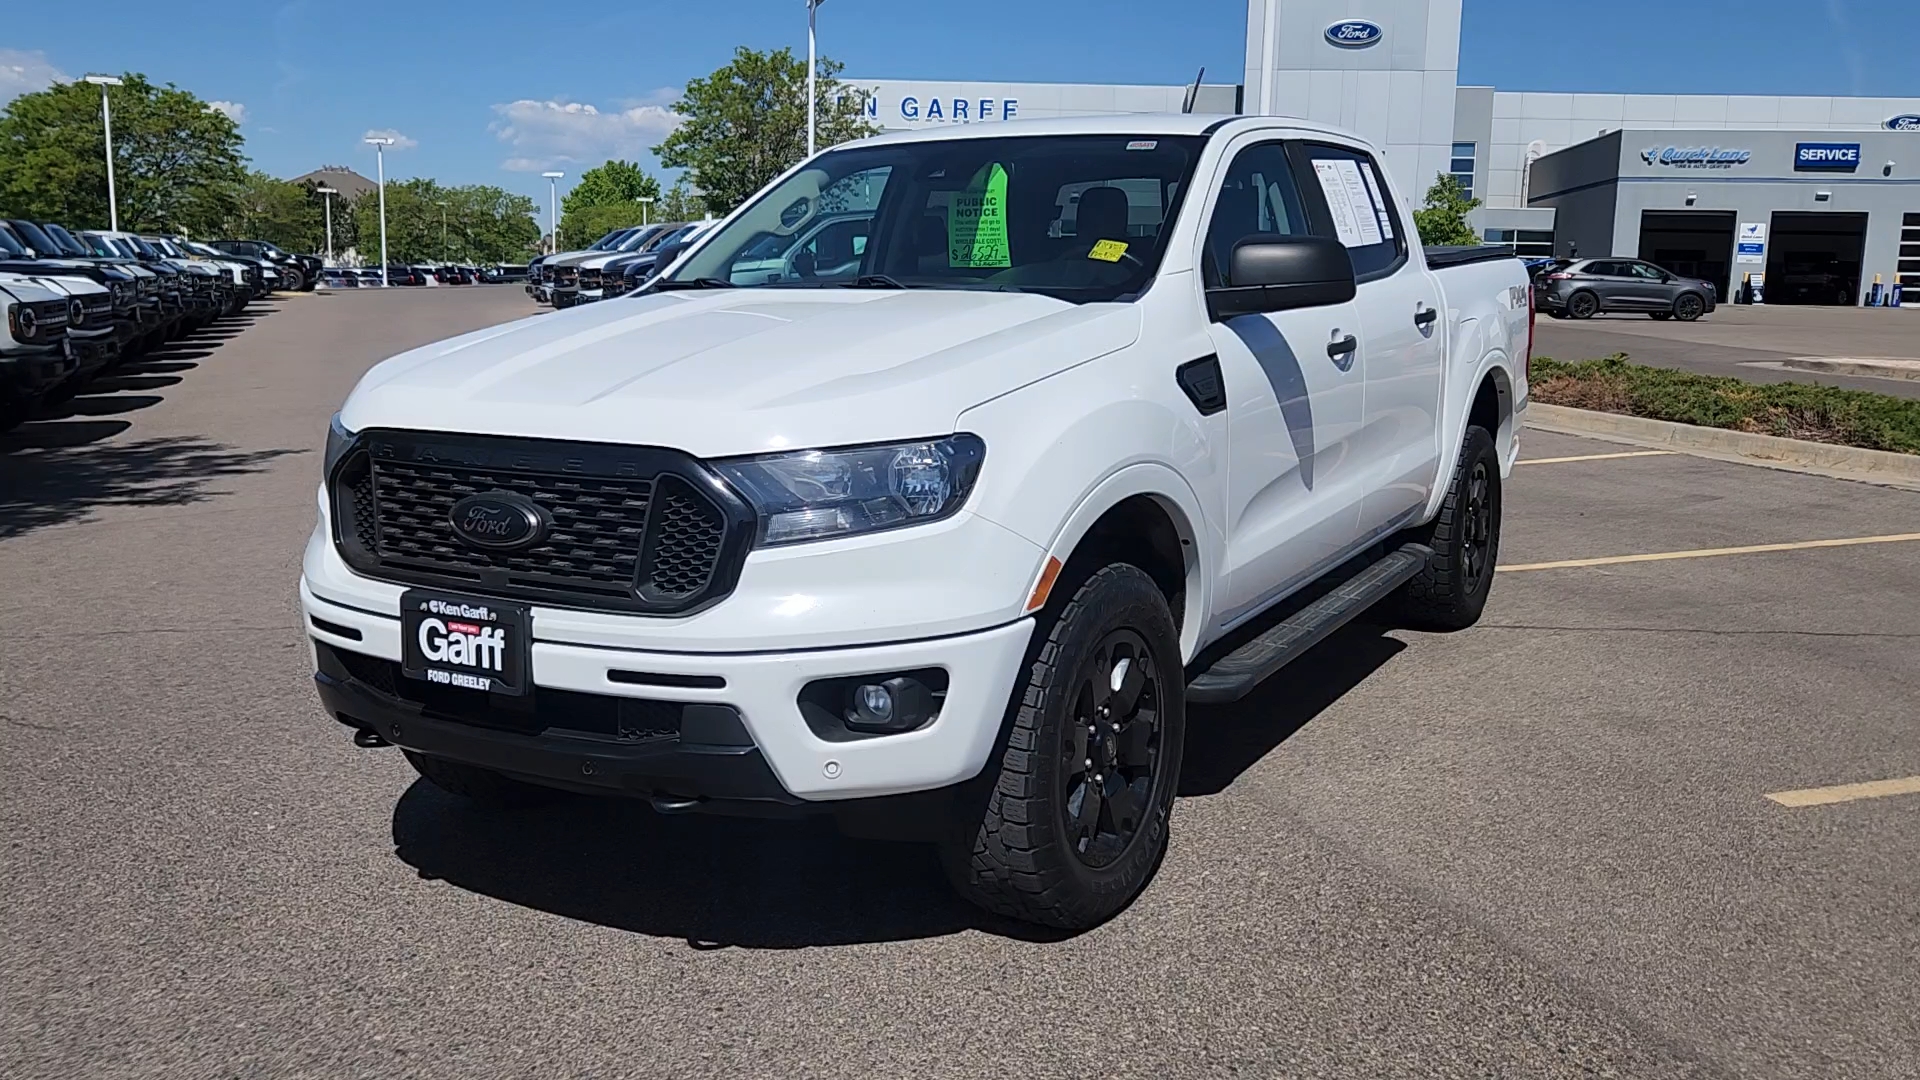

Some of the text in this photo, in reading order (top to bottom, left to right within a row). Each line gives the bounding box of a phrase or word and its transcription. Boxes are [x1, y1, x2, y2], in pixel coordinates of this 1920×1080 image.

[1338, 24, 1370, 38] Ford
[901, 97, 1018, 121] GARFF
[1661, 147, 1750, 163] Quick Lane
[1800, 149, 1857, 160] SERVICE
[956, 197, 997, 207] PUBLIC
[956, 208, 998, 217] NOTICE
[952, 249, 958, 260] $
[464, 505, 510, 535] Ford
[438, 601, 489, 620] Ken Garff
[419, 618, 505, 671] Garff
[427, 669, 491, 691] FORD GREELEY
